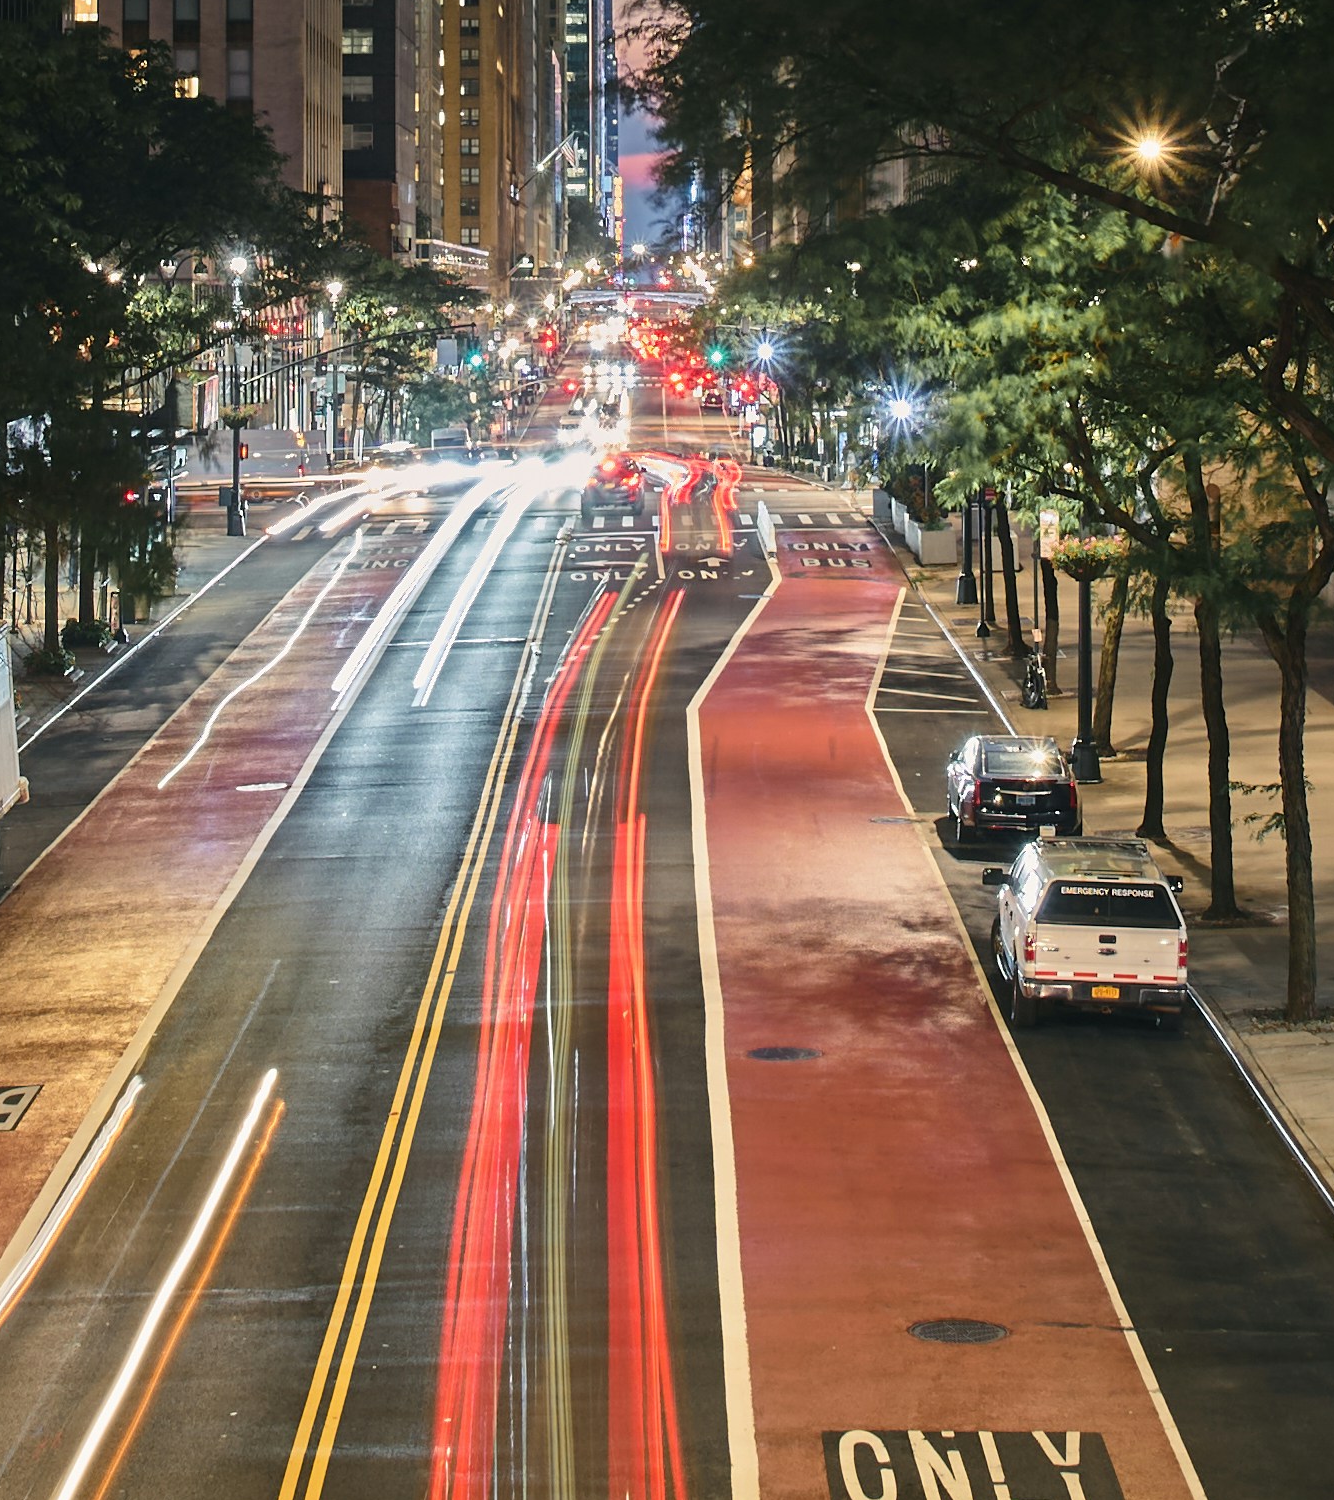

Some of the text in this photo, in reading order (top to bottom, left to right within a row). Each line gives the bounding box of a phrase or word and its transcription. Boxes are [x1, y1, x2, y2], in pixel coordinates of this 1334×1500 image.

[574, 543, 646, 552] ONLY
[793, 542, 862, 551] ONLY
[802, 558, 870, 568] BUS
[570, 571, 647, 581] ONLY
[1060, 886, 1155, 898] EMERGENCY RESPONSE
